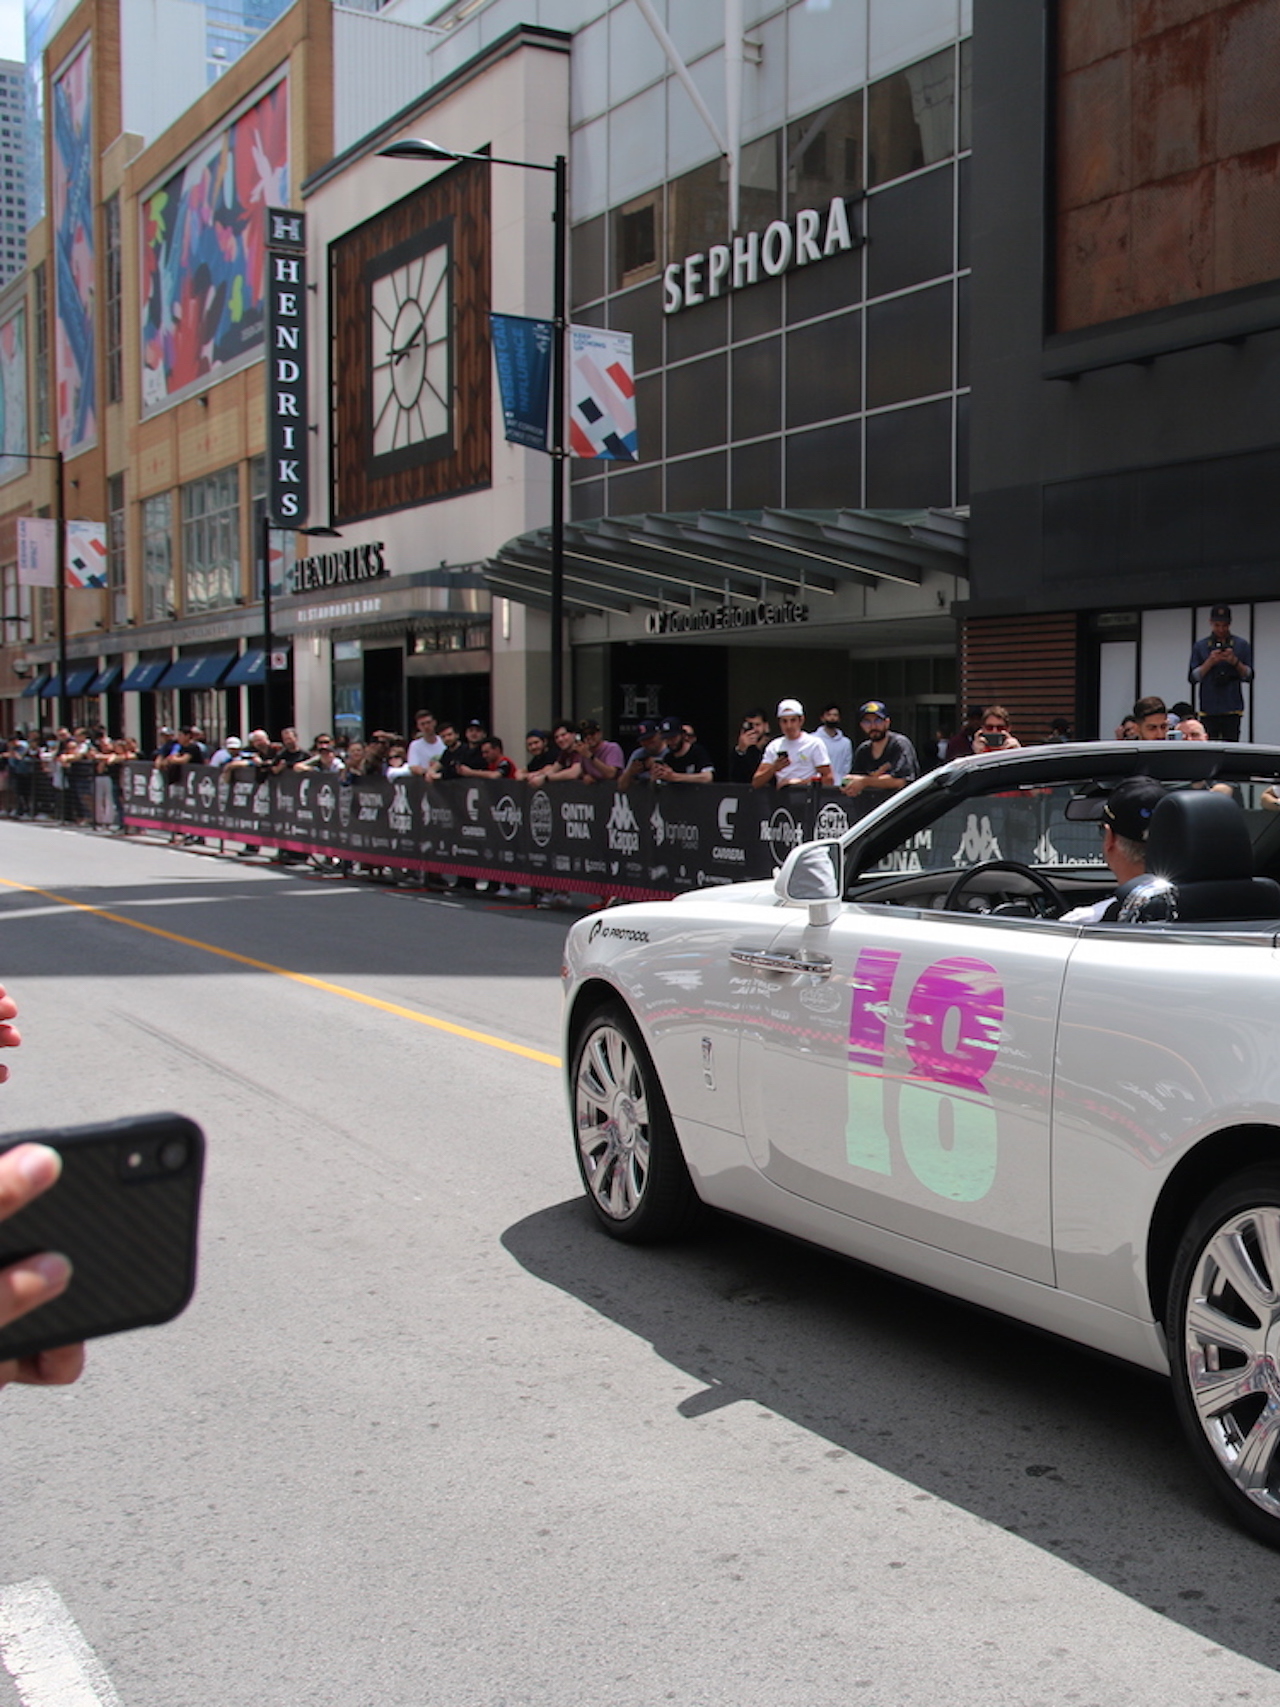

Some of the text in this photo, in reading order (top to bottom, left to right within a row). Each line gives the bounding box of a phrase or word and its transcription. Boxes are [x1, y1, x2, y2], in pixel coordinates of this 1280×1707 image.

[272, 216, 300, 241] H
[663, 196, 851, 313] SEPHORA
[275, 258, 300, 517] HENDRIKS
[292, 541, 385, 594] HENDRIKS
[664, 609, 713, 633] Toronto
[714, 604, 755, 629] Eaton
[755, 601, 803, 625] Centre
[560, 802, 595, 822] QNTM
[817, 811, 848, 830] GUM
[566, 822, 591, 840] DNA
[608, 828, 640, 856] Kappa
[665, 822, 699, 845] Ignition
[760, 820, 783, 842] Hard
[782, 820, 804, 847] Rock
[712, 846, 746, 862] CARRERA
[610, 928, 650, 943] PROTOCOL
